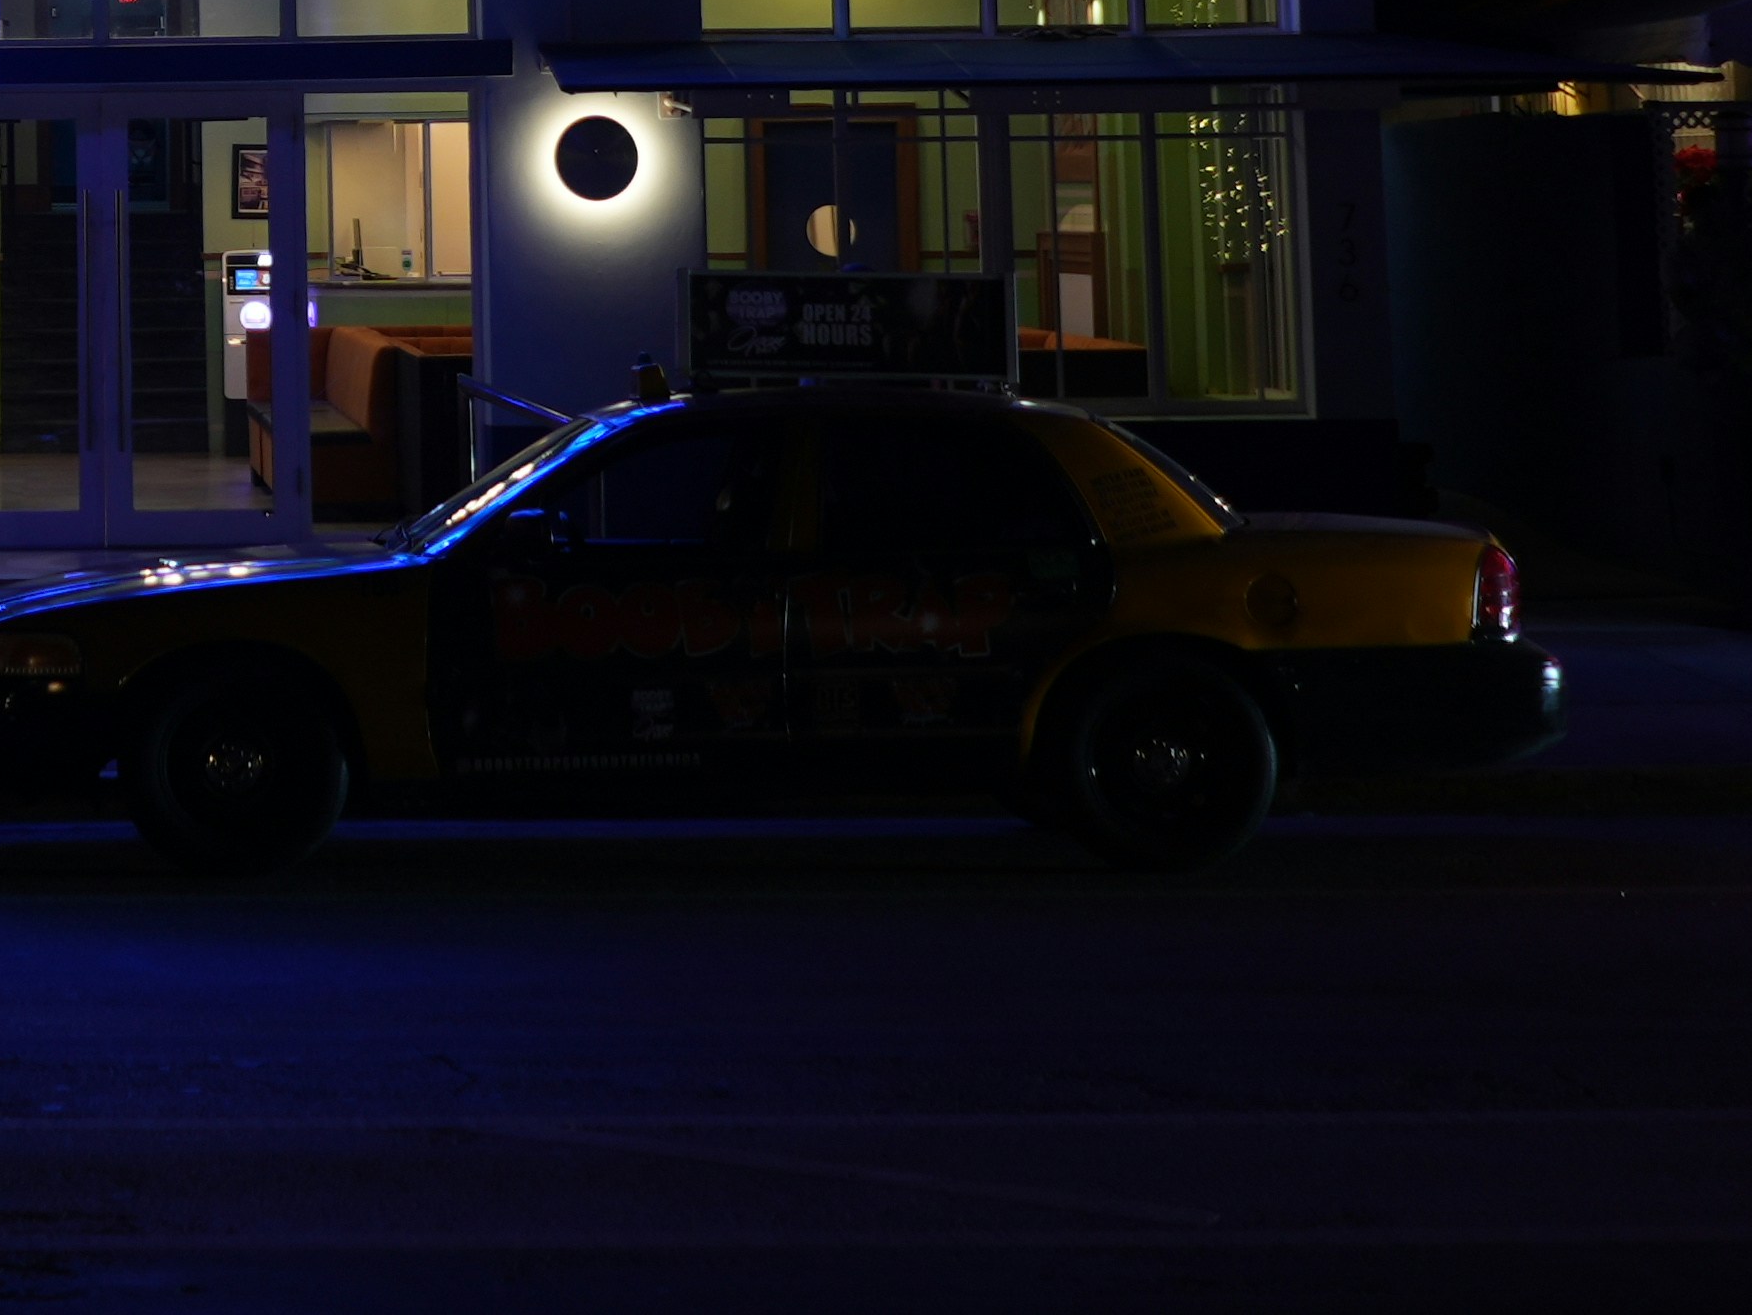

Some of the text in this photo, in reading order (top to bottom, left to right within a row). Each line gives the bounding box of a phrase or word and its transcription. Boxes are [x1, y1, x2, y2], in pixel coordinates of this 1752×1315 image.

[729, 289, 784, 304] BOOBY
[738, 305, 777, 319] TRAP
[802, 302, 874, 323] OPEN 24
[802, 324, 874, 347] HOURS
